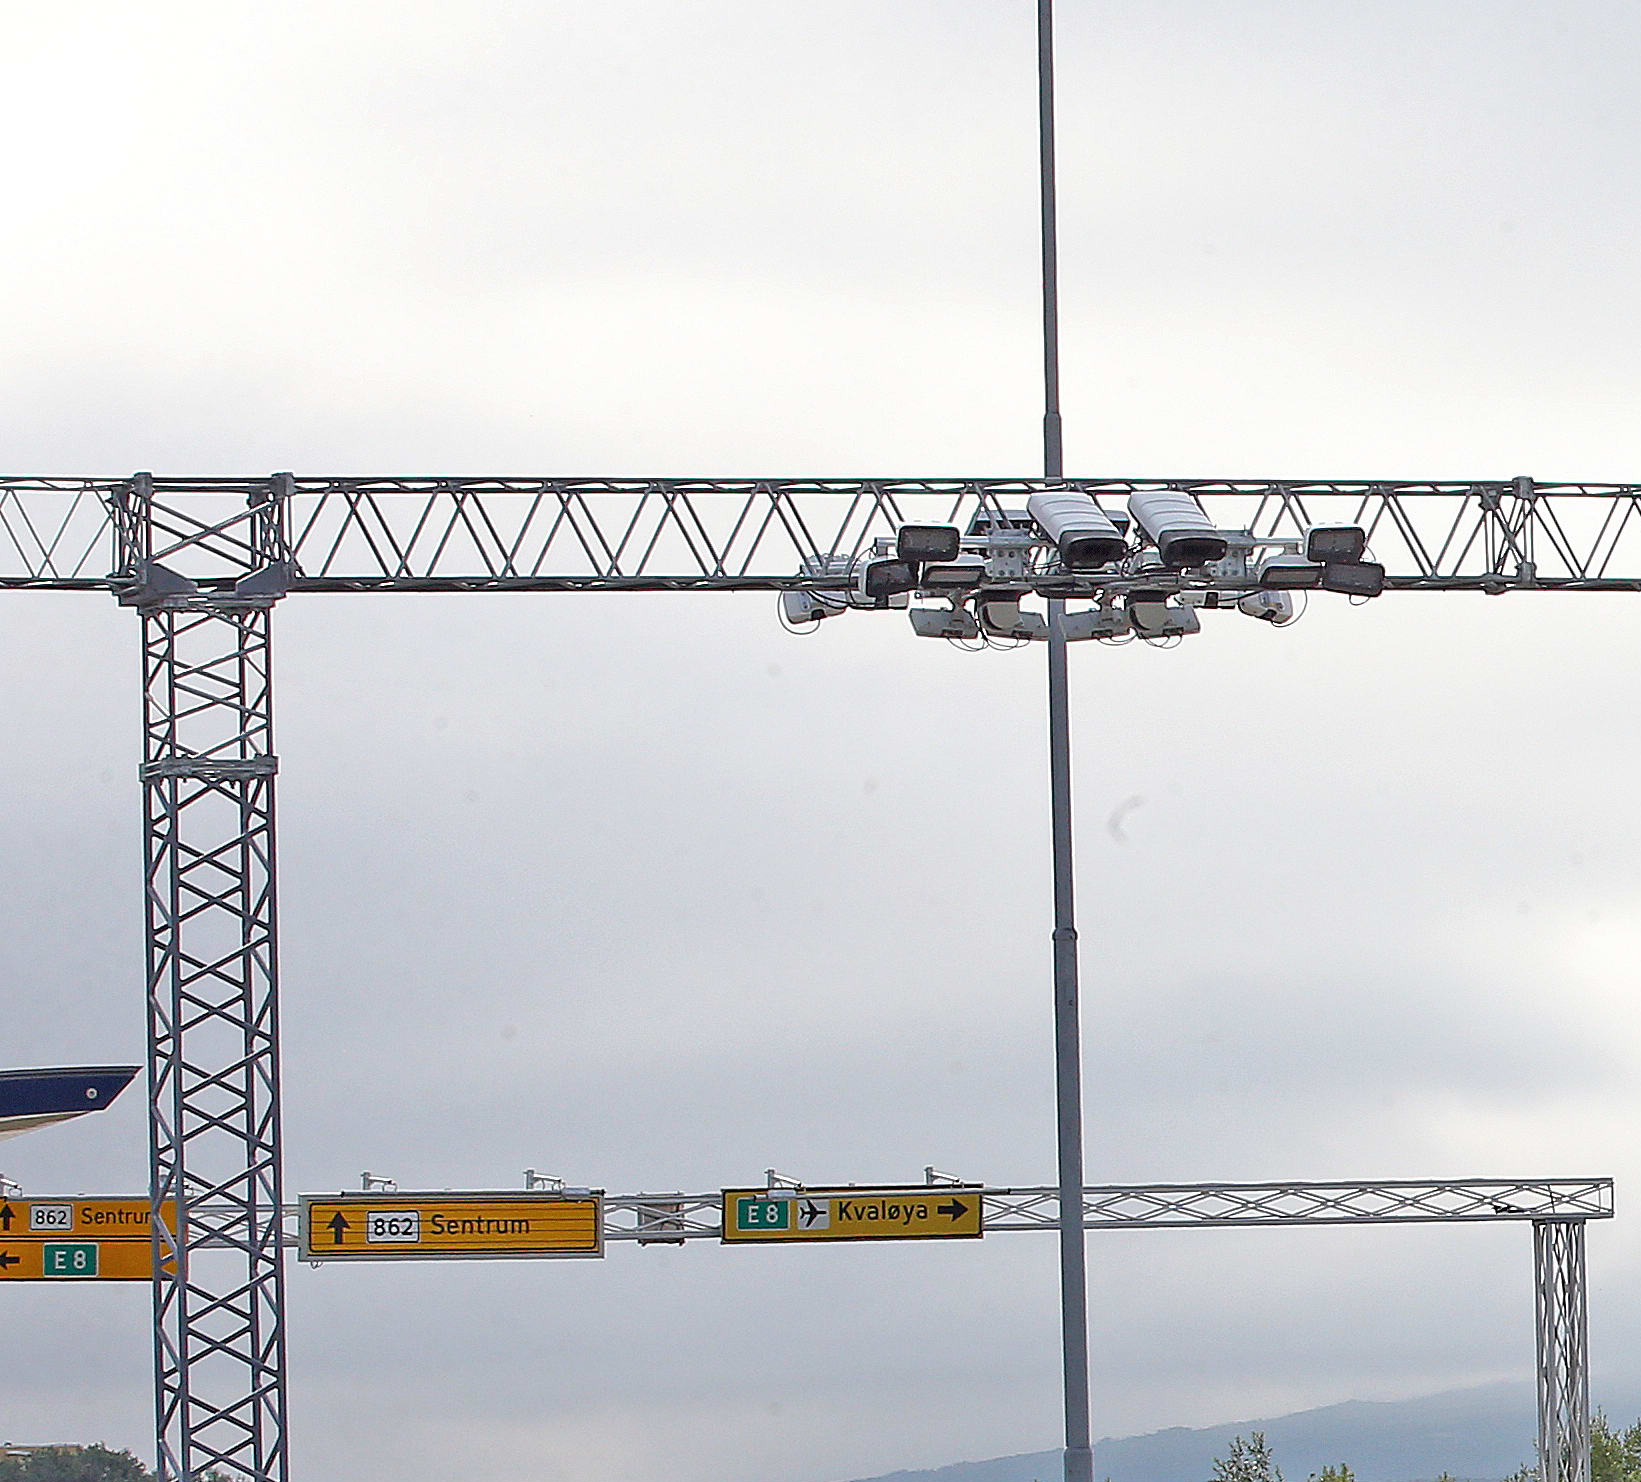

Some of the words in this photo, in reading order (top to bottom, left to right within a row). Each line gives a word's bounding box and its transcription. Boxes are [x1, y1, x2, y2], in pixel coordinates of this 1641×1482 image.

[35, 1210, 67, 1225] 862
[838, 1201, 929, 1226] Kvaløya
[373, 1217, 414, 1236] 862
[431, 1214, 530, 1235] Sentrum
